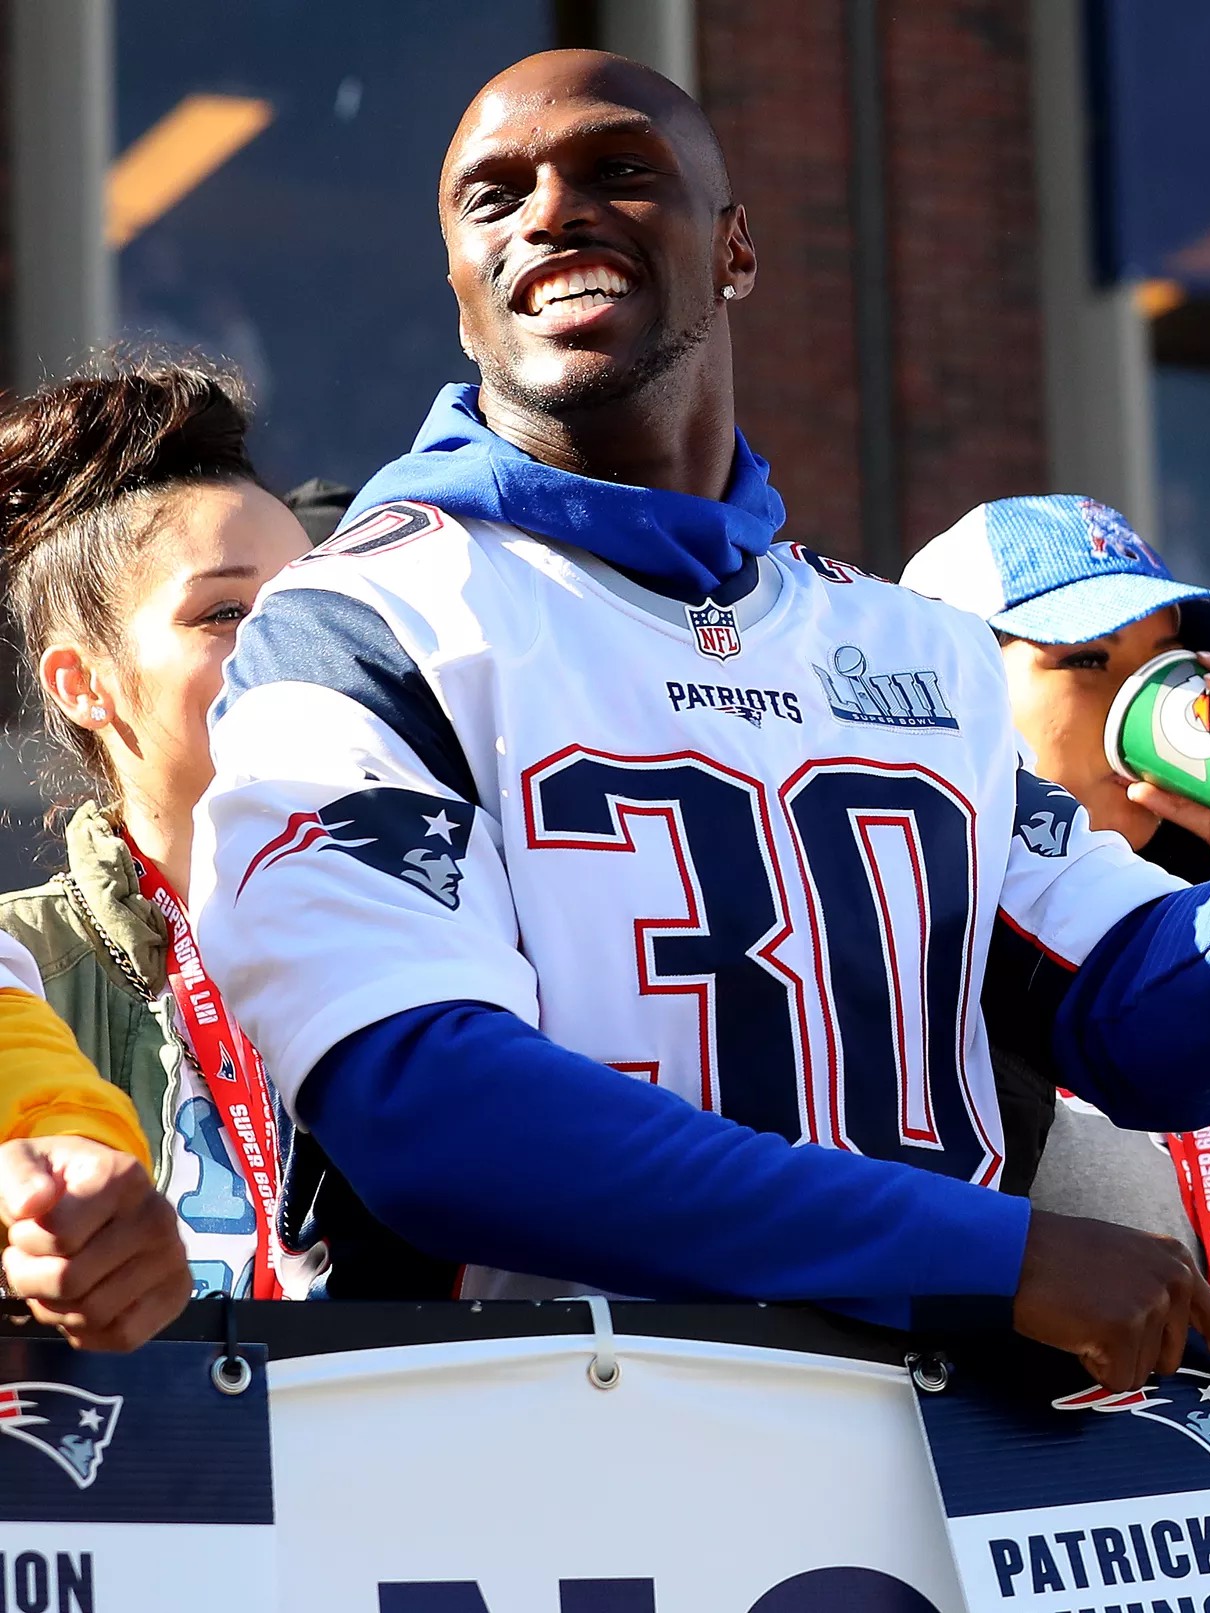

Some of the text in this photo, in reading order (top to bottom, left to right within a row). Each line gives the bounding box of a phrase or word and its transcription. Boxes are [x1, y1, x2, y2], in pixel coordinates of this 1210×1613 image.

[698, 627, 738, 654] NFL
[666, 681, 802, 724] PATRIOTS
[851, 713, 936, 726] SUPER BOWL
[152, 887, 188, 943] SUPER
[174, 935, 206, 991] BOWL
[521, 743, 1002, 1187] 30
[228, 1103, 265, 1168] SUPER
[0, 1551, 94, 1613] ON
